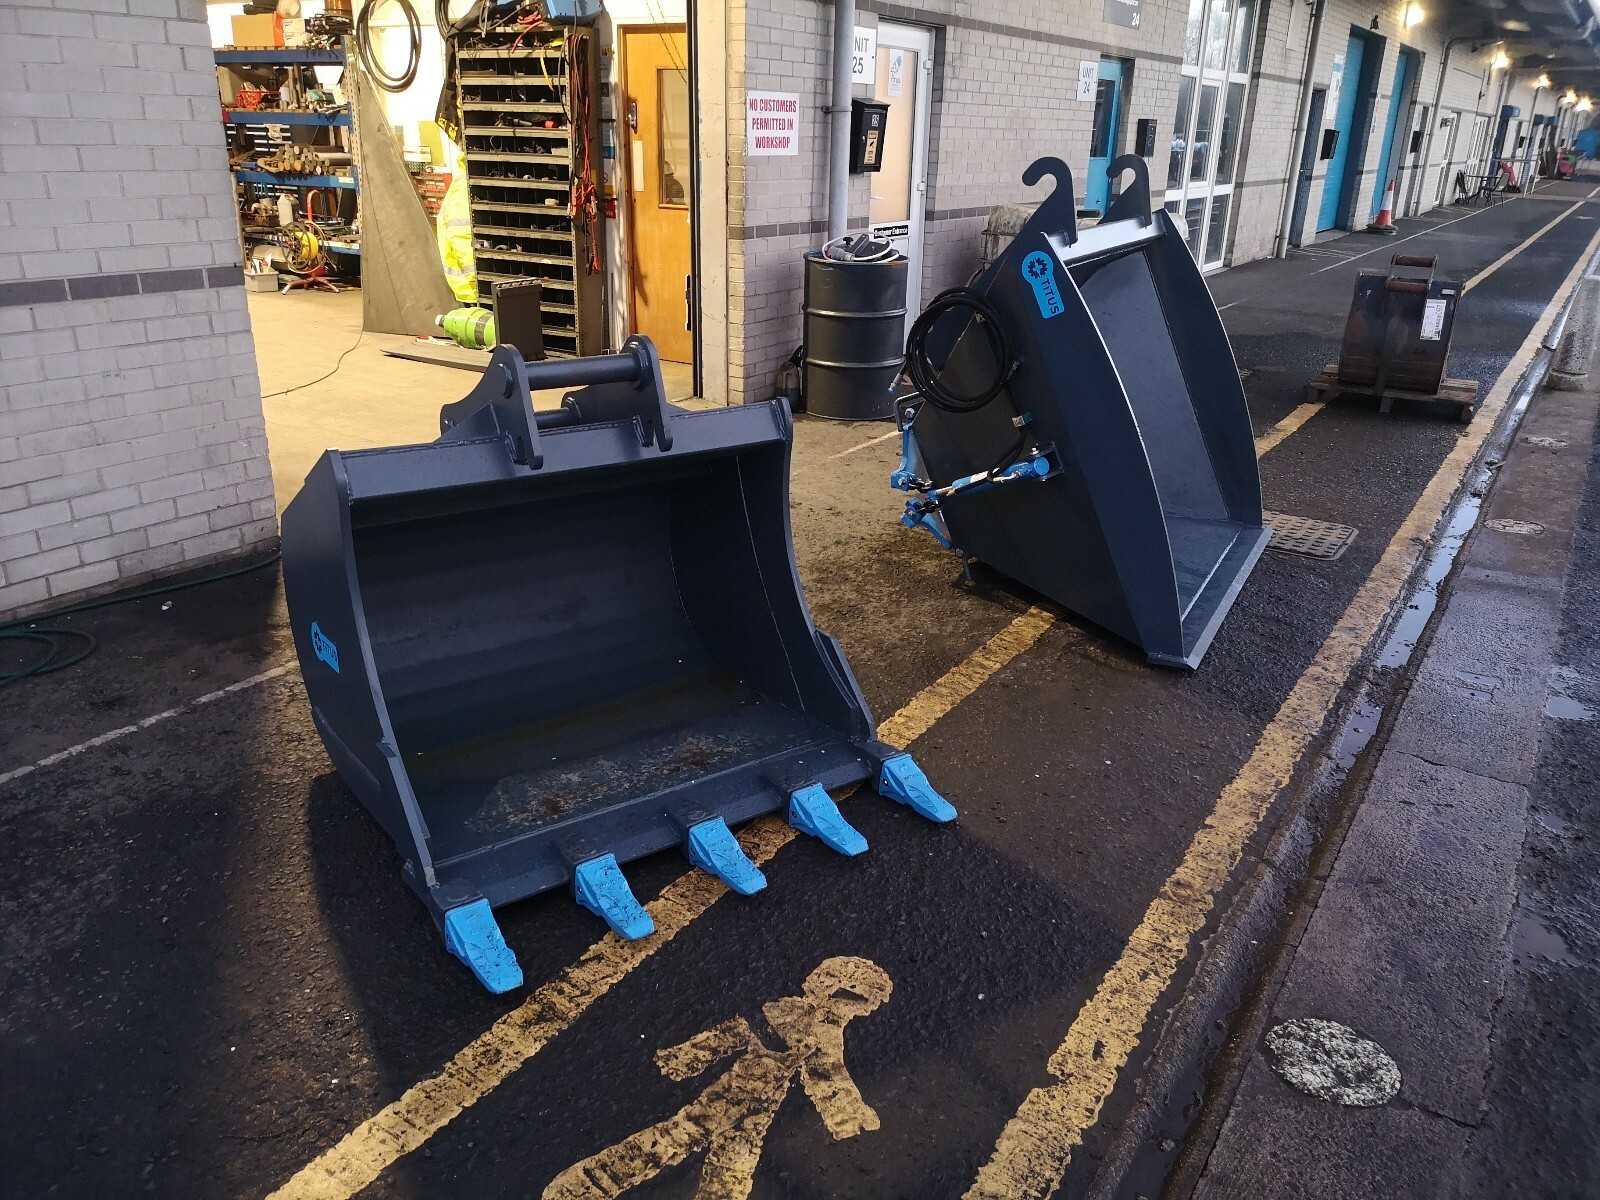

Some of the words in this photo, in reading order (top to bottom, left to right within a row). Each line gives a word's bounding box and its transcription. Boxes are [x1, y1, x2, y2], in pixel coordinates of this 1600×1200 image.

[1132, 12, 1140, 26] 24
[854, 36, 870, 53] NIT
[852, 56, 864, 74] 25
[1082, 66, 1095, 79] UNIT
[1083, 81, 1091, 94] 24
[749, 98, 758, 111] NO
[759, 99, 797, 113] CUSTOMERS
[752, 117, 786, 131] PERMITTED
[787, 118, 794, 131] IN
[755, 136, 791, 149] WORKSHOP
